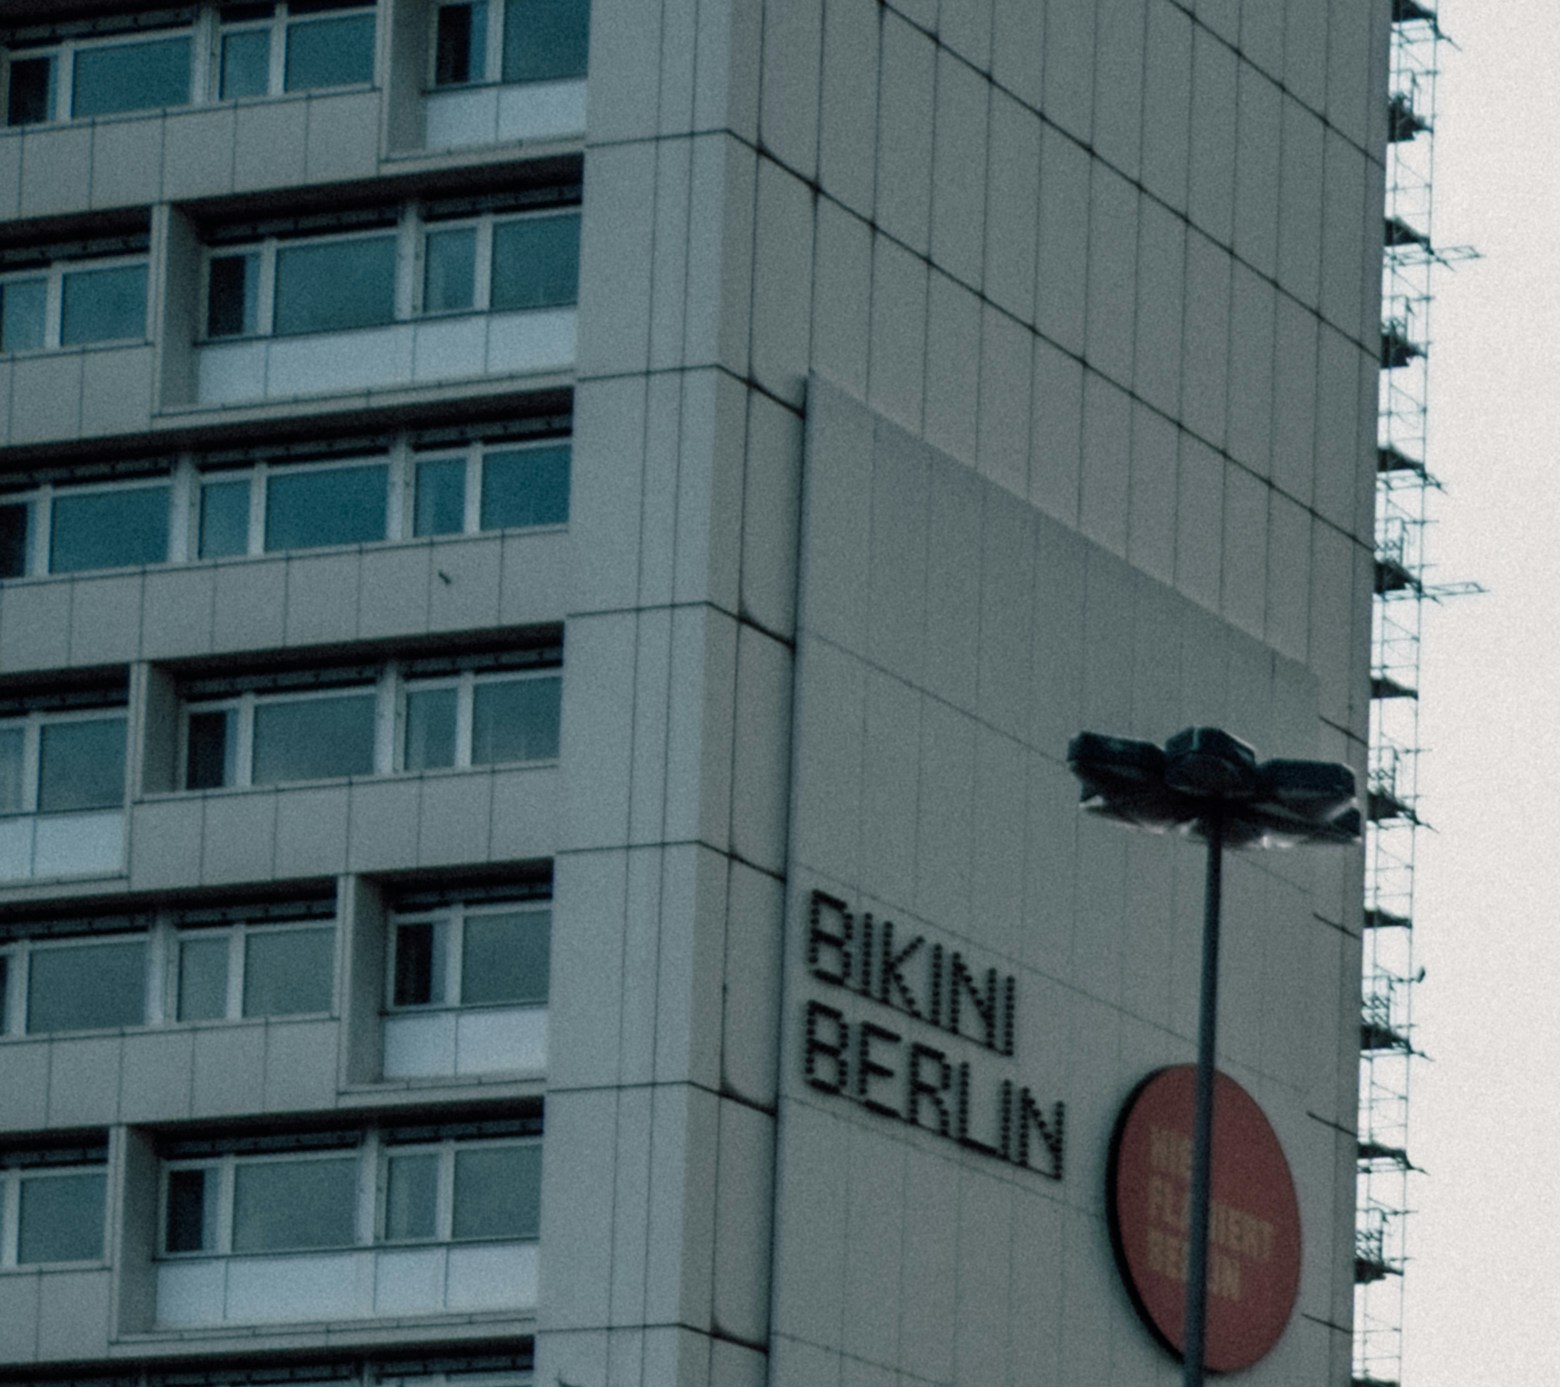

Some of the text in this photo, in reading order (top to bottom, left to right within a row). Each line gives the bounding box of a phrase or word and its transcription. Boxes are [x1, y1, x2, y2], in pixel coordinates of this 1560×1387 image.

[807, 889, 1016, 1057] BIKINI
[804, 1000, 1065, 1182] BERLIN
[1149, 1126, 1194, 1177] HIE
